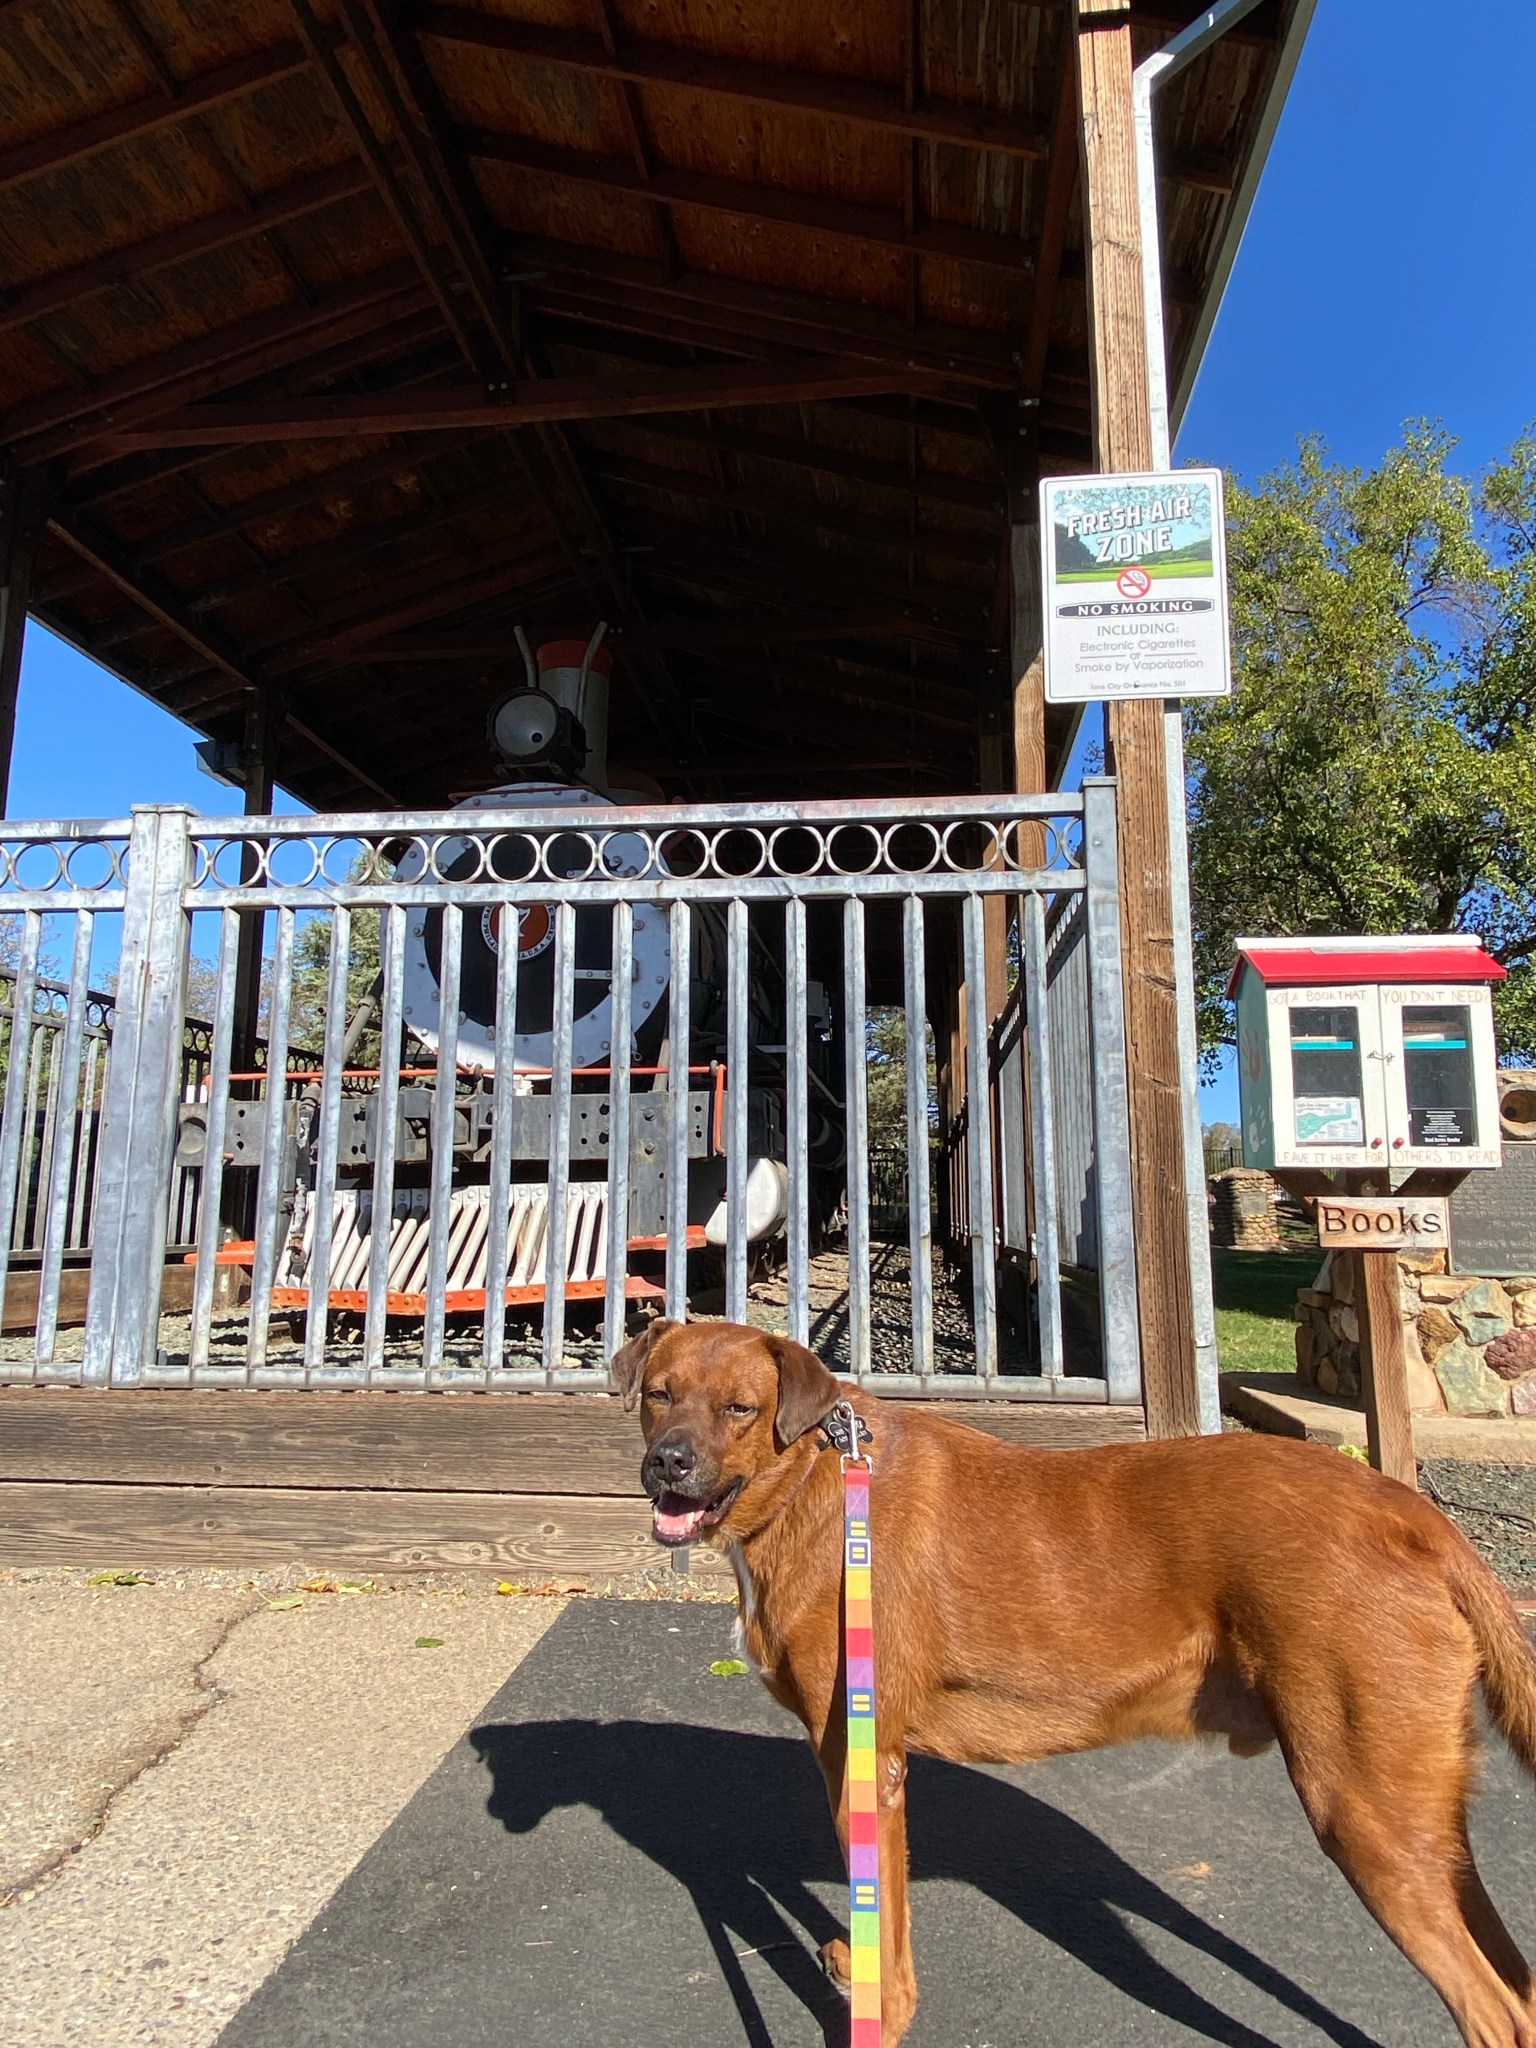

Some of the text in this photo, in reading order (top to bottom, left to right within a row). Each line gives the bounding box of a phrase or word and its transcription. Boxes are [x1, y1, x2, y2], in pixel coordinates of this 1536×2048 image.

[1067, 496, 1192, 538] FRESH AIR
[1095, 526, 1173, 563] ZONE
[1078, 600, 1194, 616] NO SMOKING
[1096, 623, 1179, 637] INCLUDING:
[1080, 639, 1196, 652] Electronic Cigarettes
[1129, 652, 1141, 660] or
[1074, 659, 1204, 673] Smoke by Vaporization
[1107, 682, 1121, 690] City
[1123, 681, 1158, 690] Ornance
[1268, 991, 1288, 1005] GOT
[1292, 992, 1299, 1003] A
[1306, 990, 1336, 1002] BOOK
[1337, 989, 1367, 1001] THAT
[1382, 989, 1407, 1004] YOU
[1451, 989, 1489, 1003] NEED?
[1277, 1150, 1499, 1164] LEAVE IT HERE FOR OTHERS TO READ
[1321, 1206, 1441, 1234] Books
